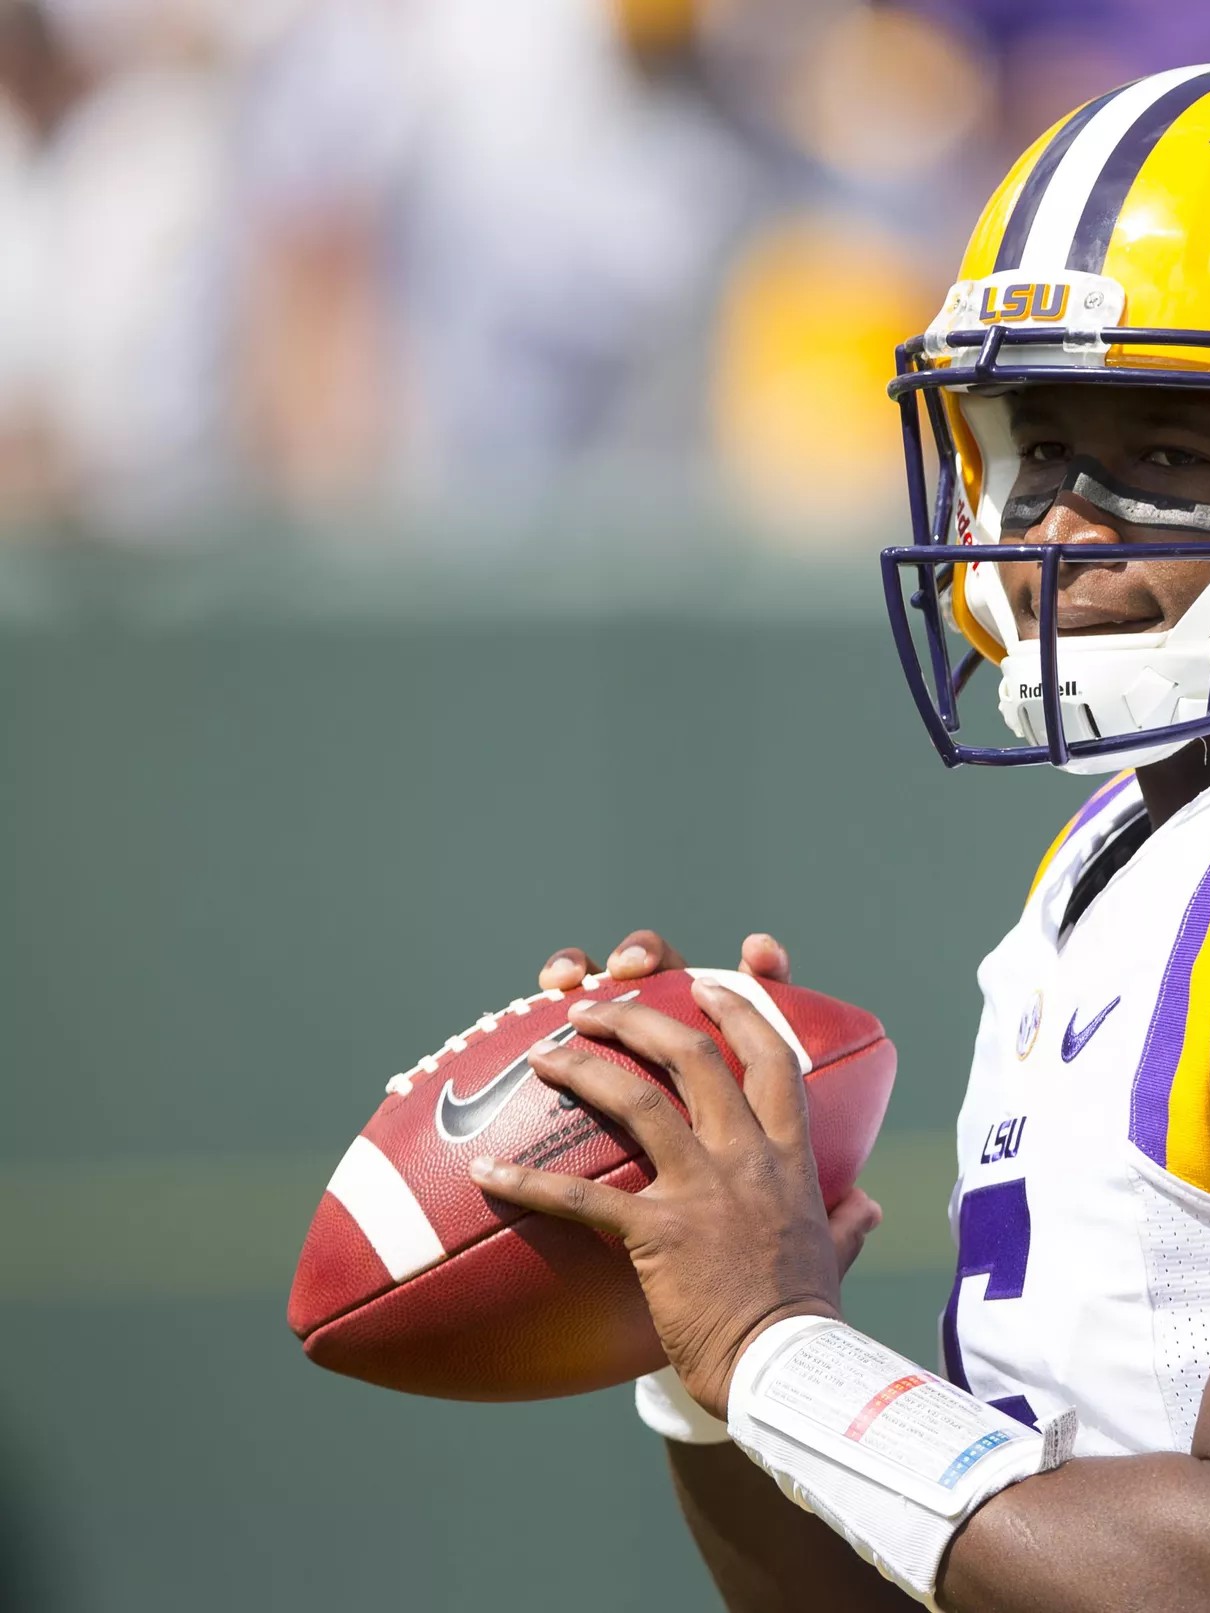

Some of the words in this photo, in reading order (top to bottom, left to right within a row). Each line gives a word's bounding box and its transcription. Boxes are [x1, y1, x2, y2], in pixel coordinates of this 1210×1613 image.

[978, 282, 1072, 324] LSU
[1020, 681, 1076, 699] Ridell
[980, 1115, 1027, 1165] LSU
